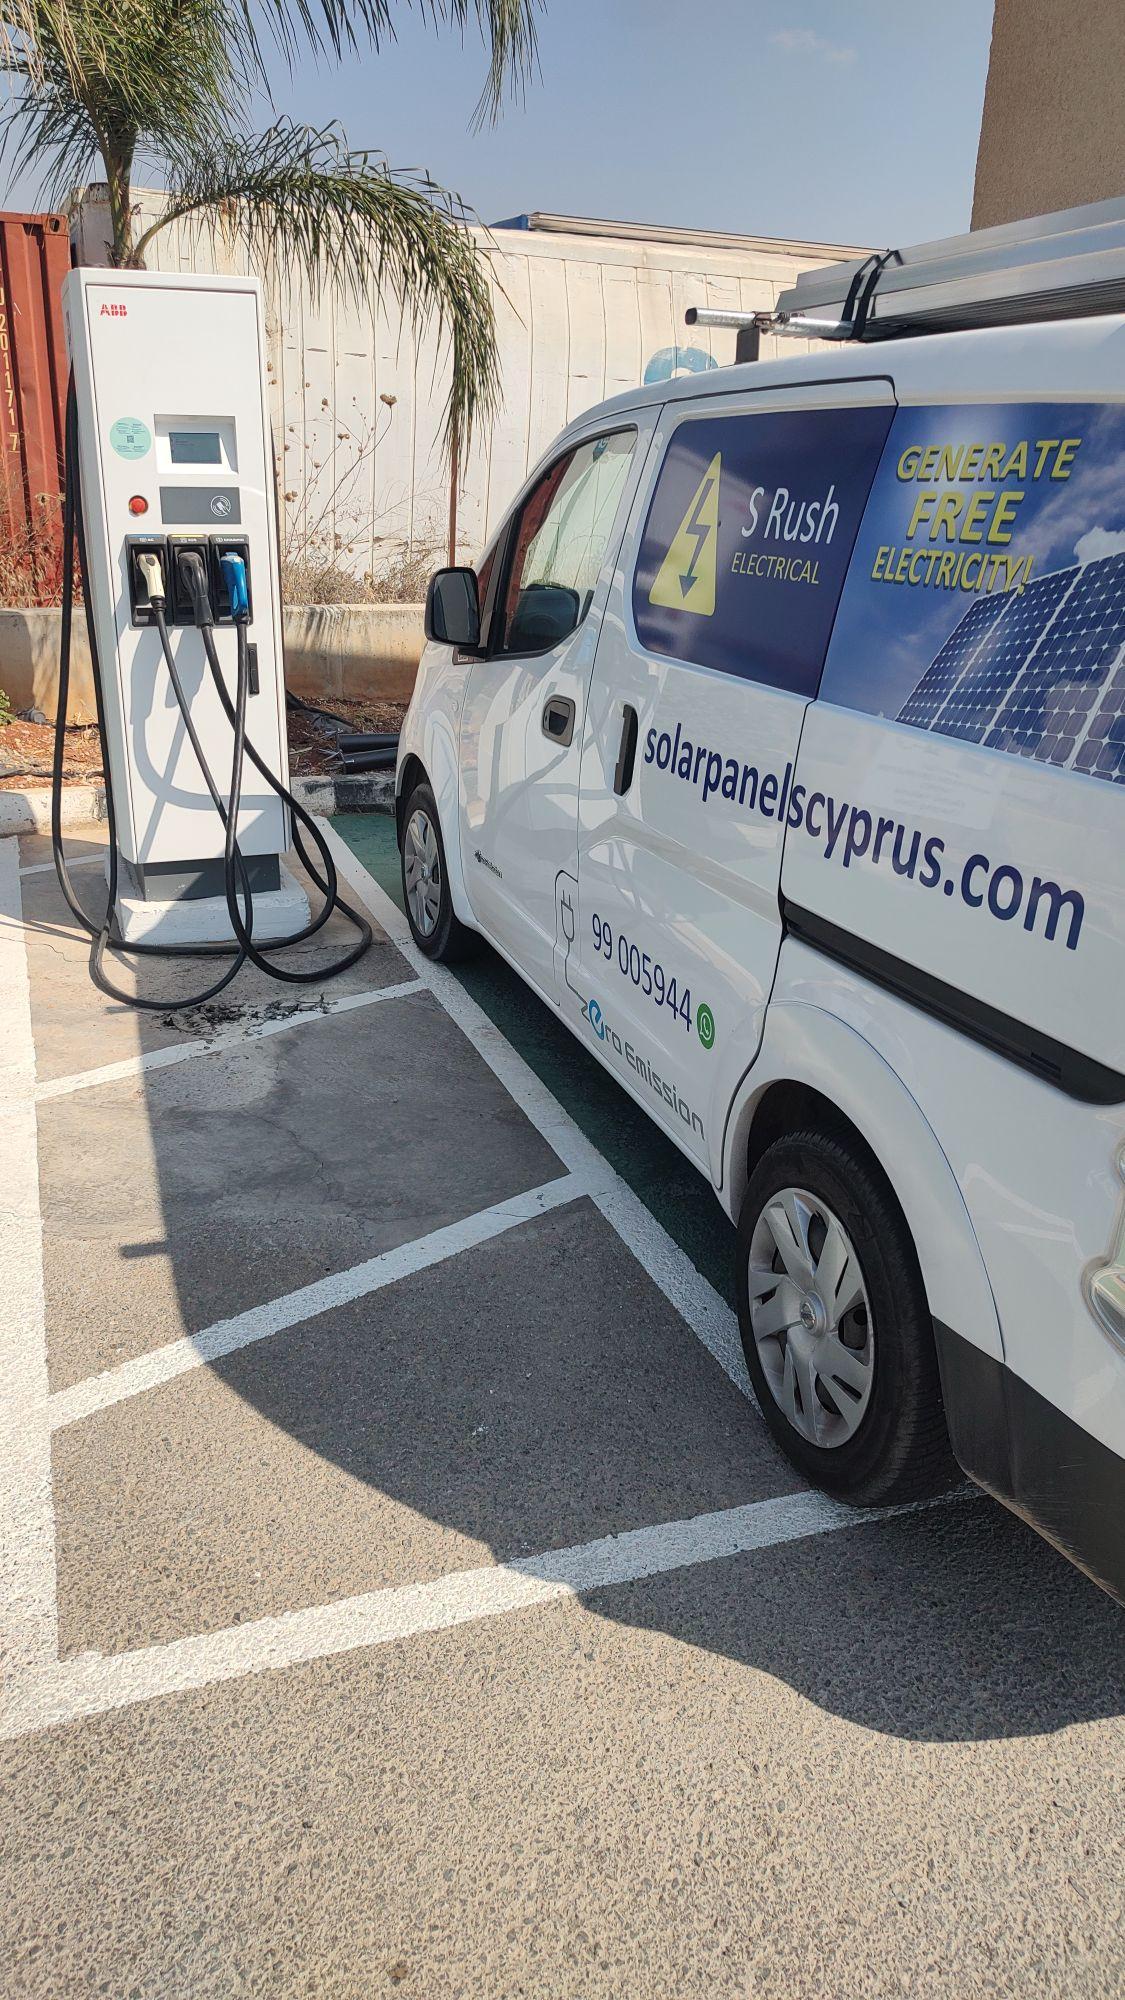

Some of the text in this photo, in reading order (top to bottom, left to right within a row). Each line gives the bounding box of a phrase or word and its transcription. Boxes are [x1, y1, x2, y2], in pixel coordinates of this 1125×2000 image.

[100, 304, 128, 316] ABB
[897, 438, 1082, 482] GENERATE
[741, 485, 840, 544] S Rush
[906, 491, 1025, 546] FREE
[731, 552, 820, 584] ELECTRICAL
[871, 545, 1035, 597] ELECTRICITY!
[644, 722, 1086, 951] solarpanelscyprus.com
[592, 913, 692, 1032] 99 005944
[625, 1042, 705, 1141] Emission
